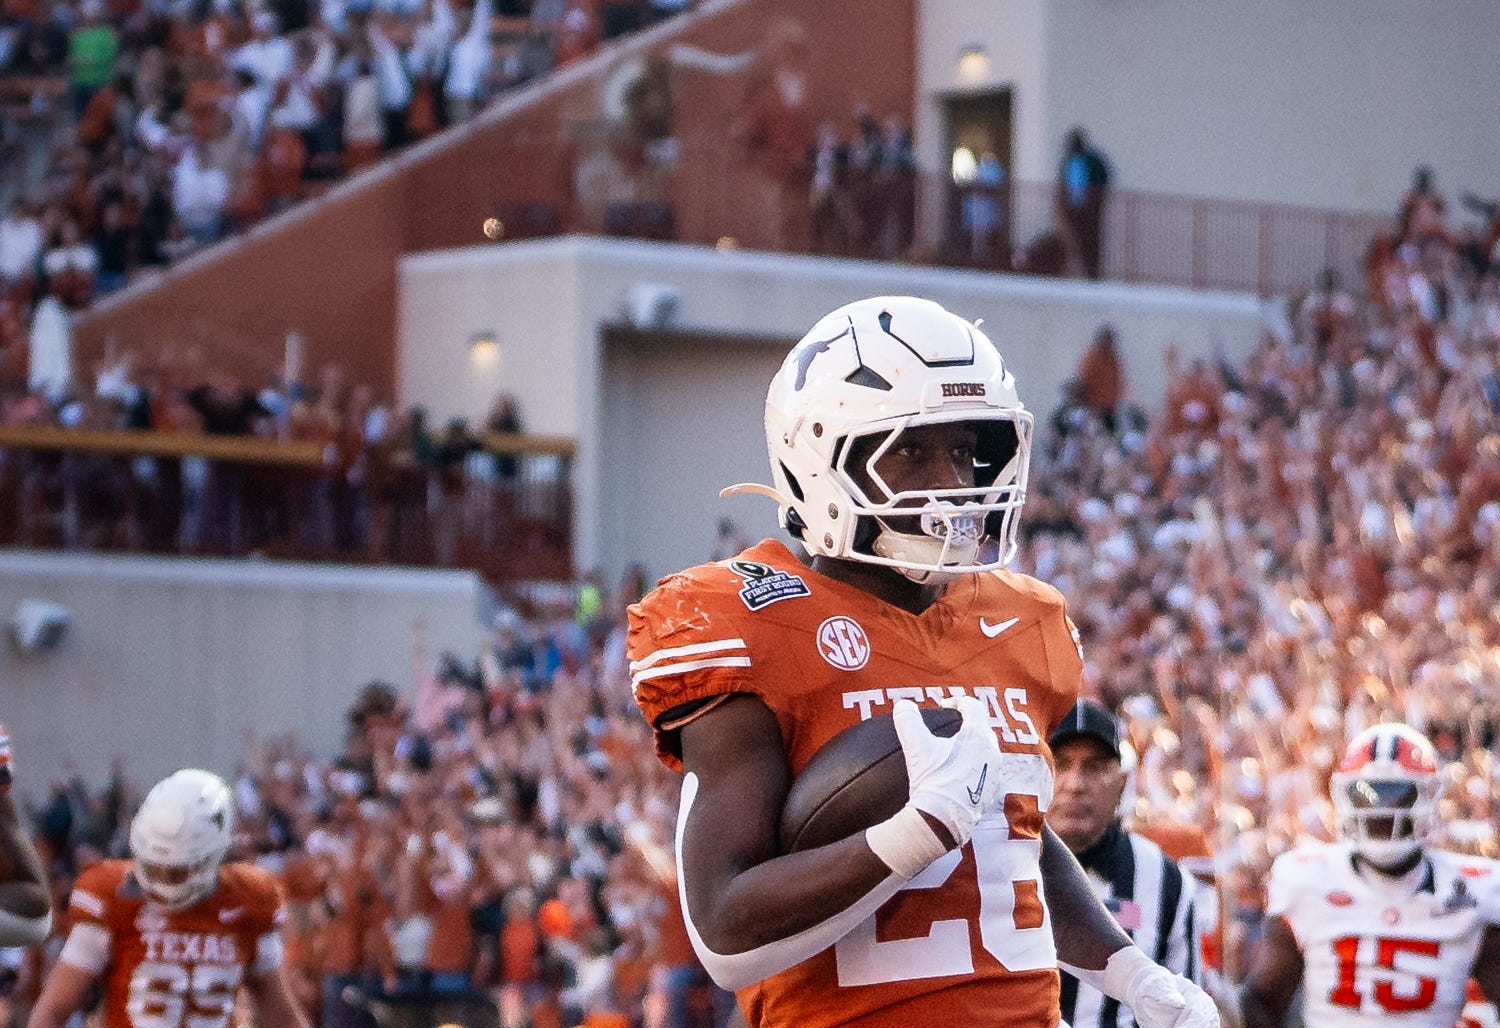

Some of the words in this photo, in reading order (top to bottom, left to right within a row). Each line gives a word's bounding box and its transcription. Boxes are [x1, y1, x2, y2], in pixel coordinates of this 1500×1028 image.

[941, 383, 985, 397] HORNS
[744, 583, 775, 600] FIRST
[820, 620, 867, 667] SEC
[842, 686, 1040, 746] TAS
[140, 932, 238, 962] TEXAS
[1329, 934, 1441, 1013] 15
